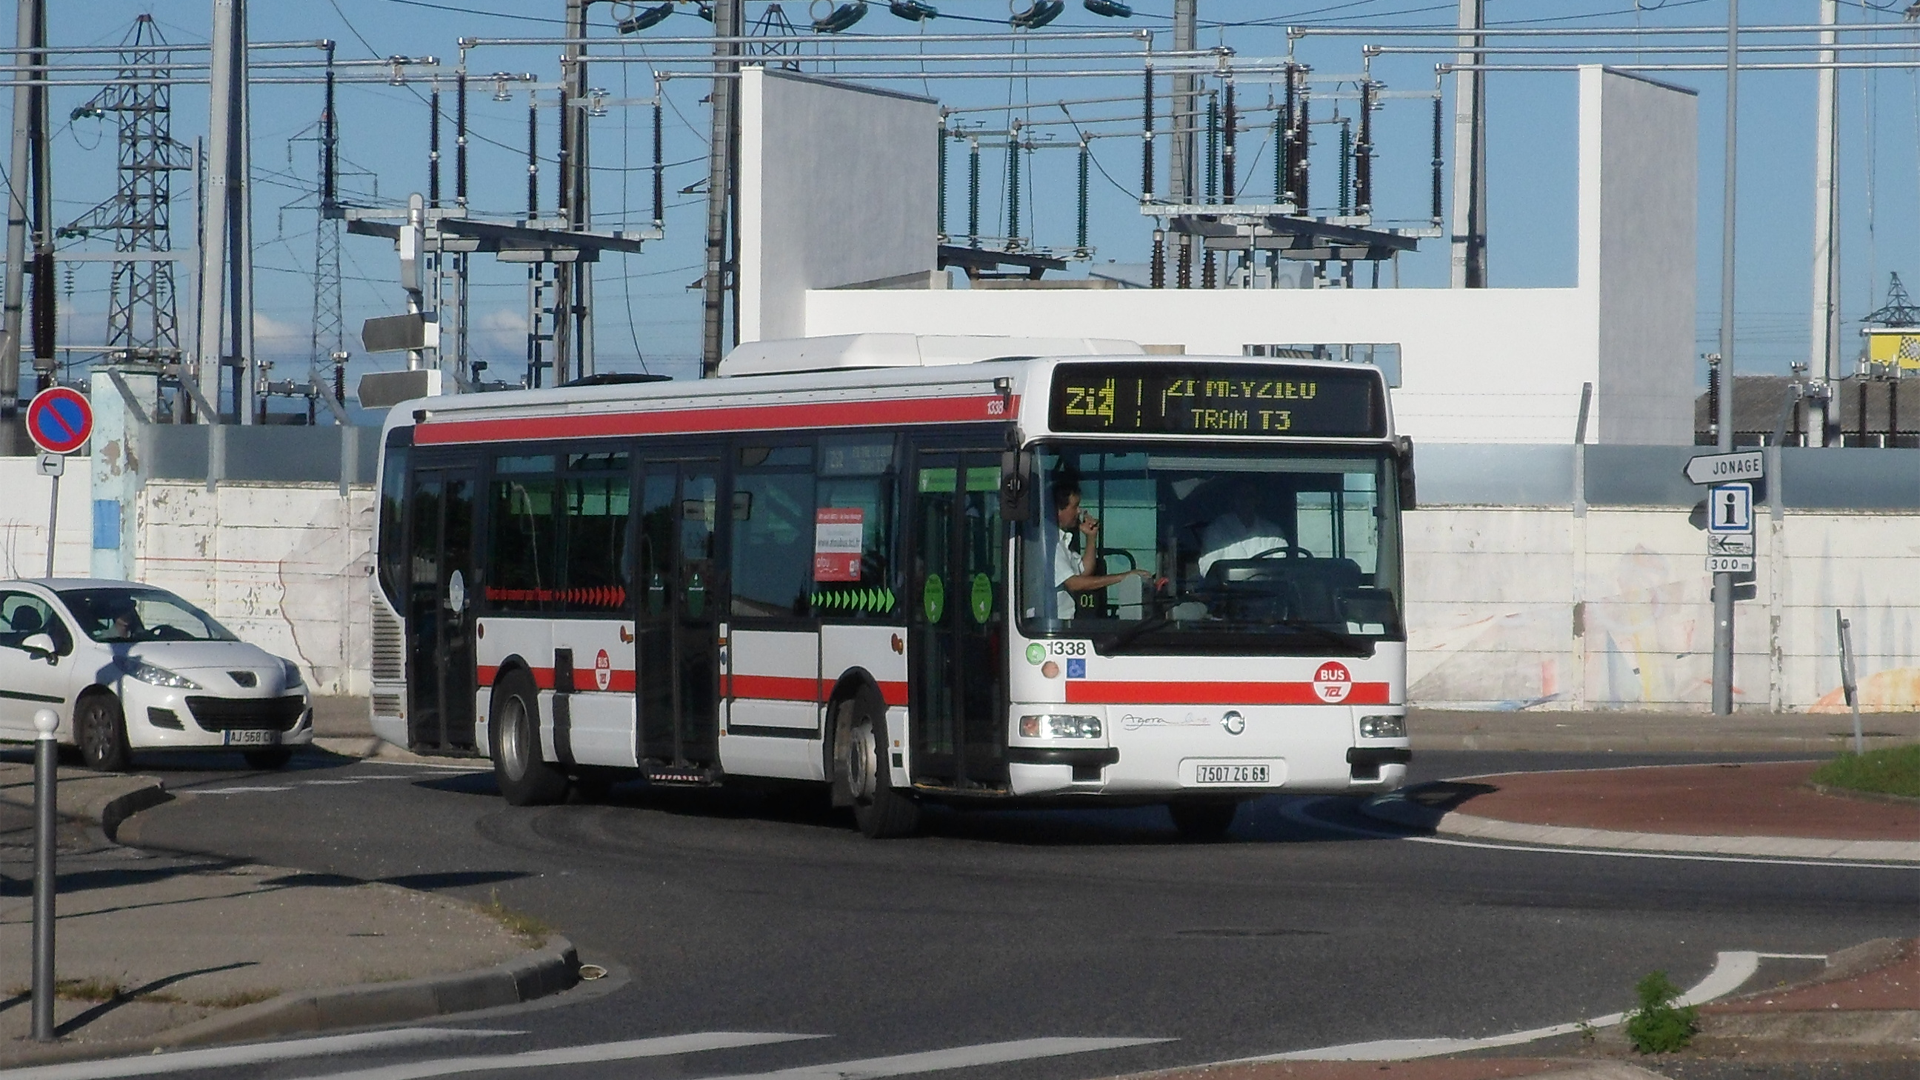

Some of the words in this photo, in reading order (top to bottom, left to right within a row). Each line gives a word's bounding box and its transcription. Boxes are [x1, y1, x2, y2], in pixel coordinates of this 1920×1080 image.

[987, 400, 1004, 415] 1338
[1191, 409, 1248, 429] TRAM
[1259, 410, 1291, 430] T3
[1713, 459, 1759, 475] JONAGE
[1711, 559, 1738, 570] 300
[1080, 594, 1095, 608] 01
[1047, 641, 1086, 656] 1338
[1321, 669, 1345, 681] BUS
[231, 732, 242, 742] AJ
[245, 732, 260, 742] 568
[1201, 767, 1230, 781] 7507
[1234, 767, 1249, 781] ZG
[1252, 767, 1266, 781] 69
